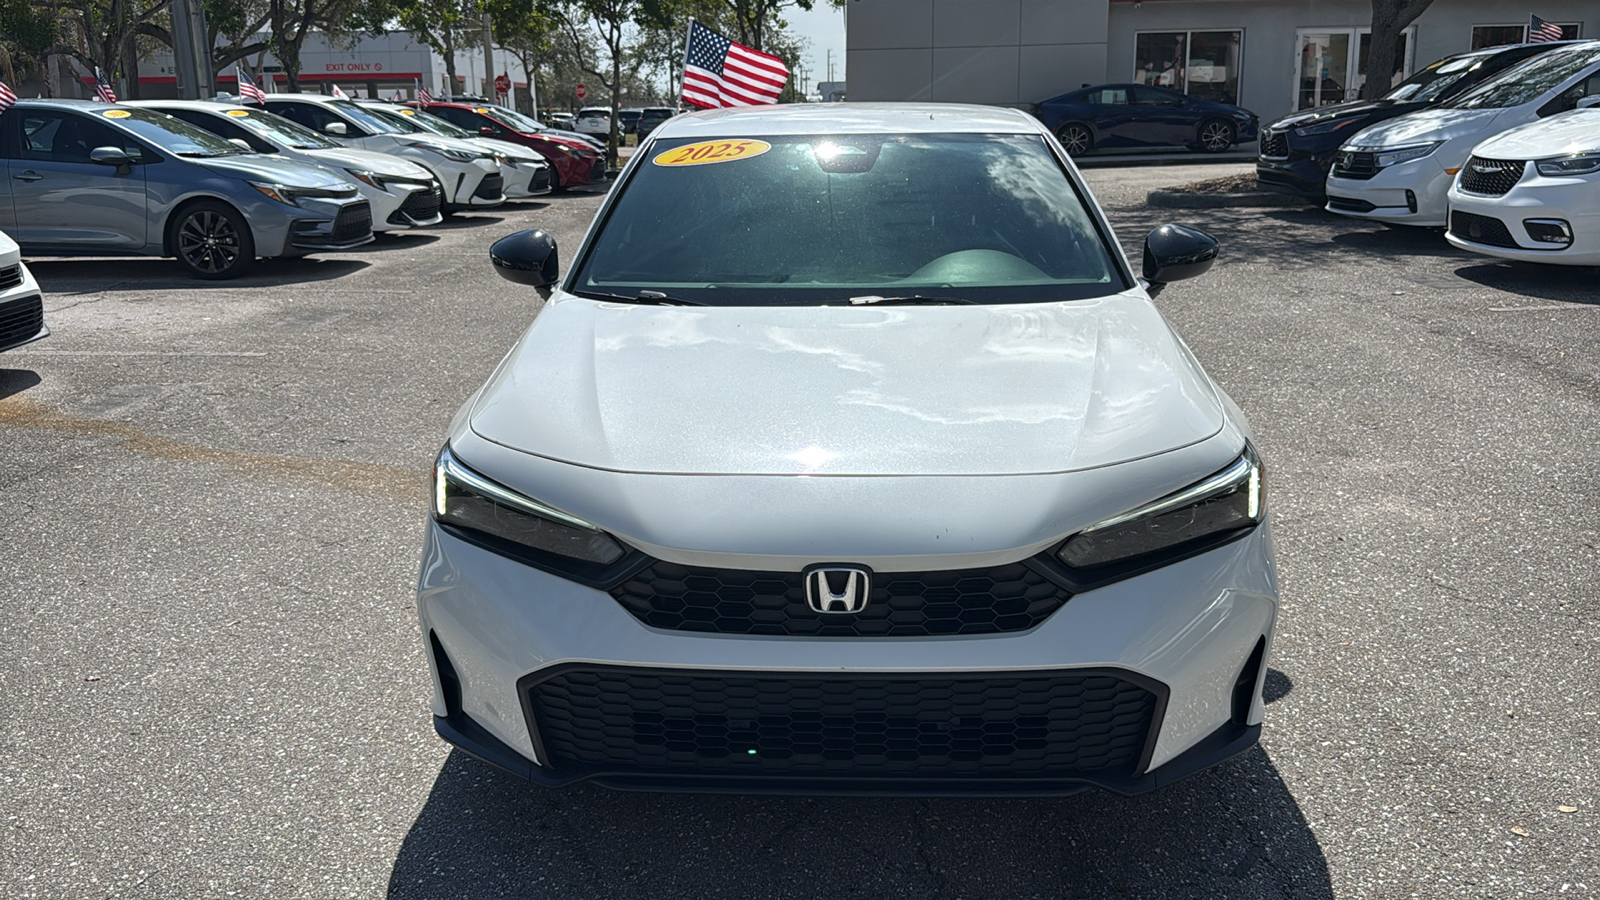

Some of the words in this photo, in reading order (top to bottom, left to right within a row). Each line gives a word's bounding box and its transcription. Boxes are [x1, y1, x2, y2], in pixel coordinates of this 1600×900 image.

[326, 63, 345, 71] EXIT
[347, 63, 371, 71] ONLY
[669, 142, 752, 163] 2025
[816, 570, 858, 612] H
